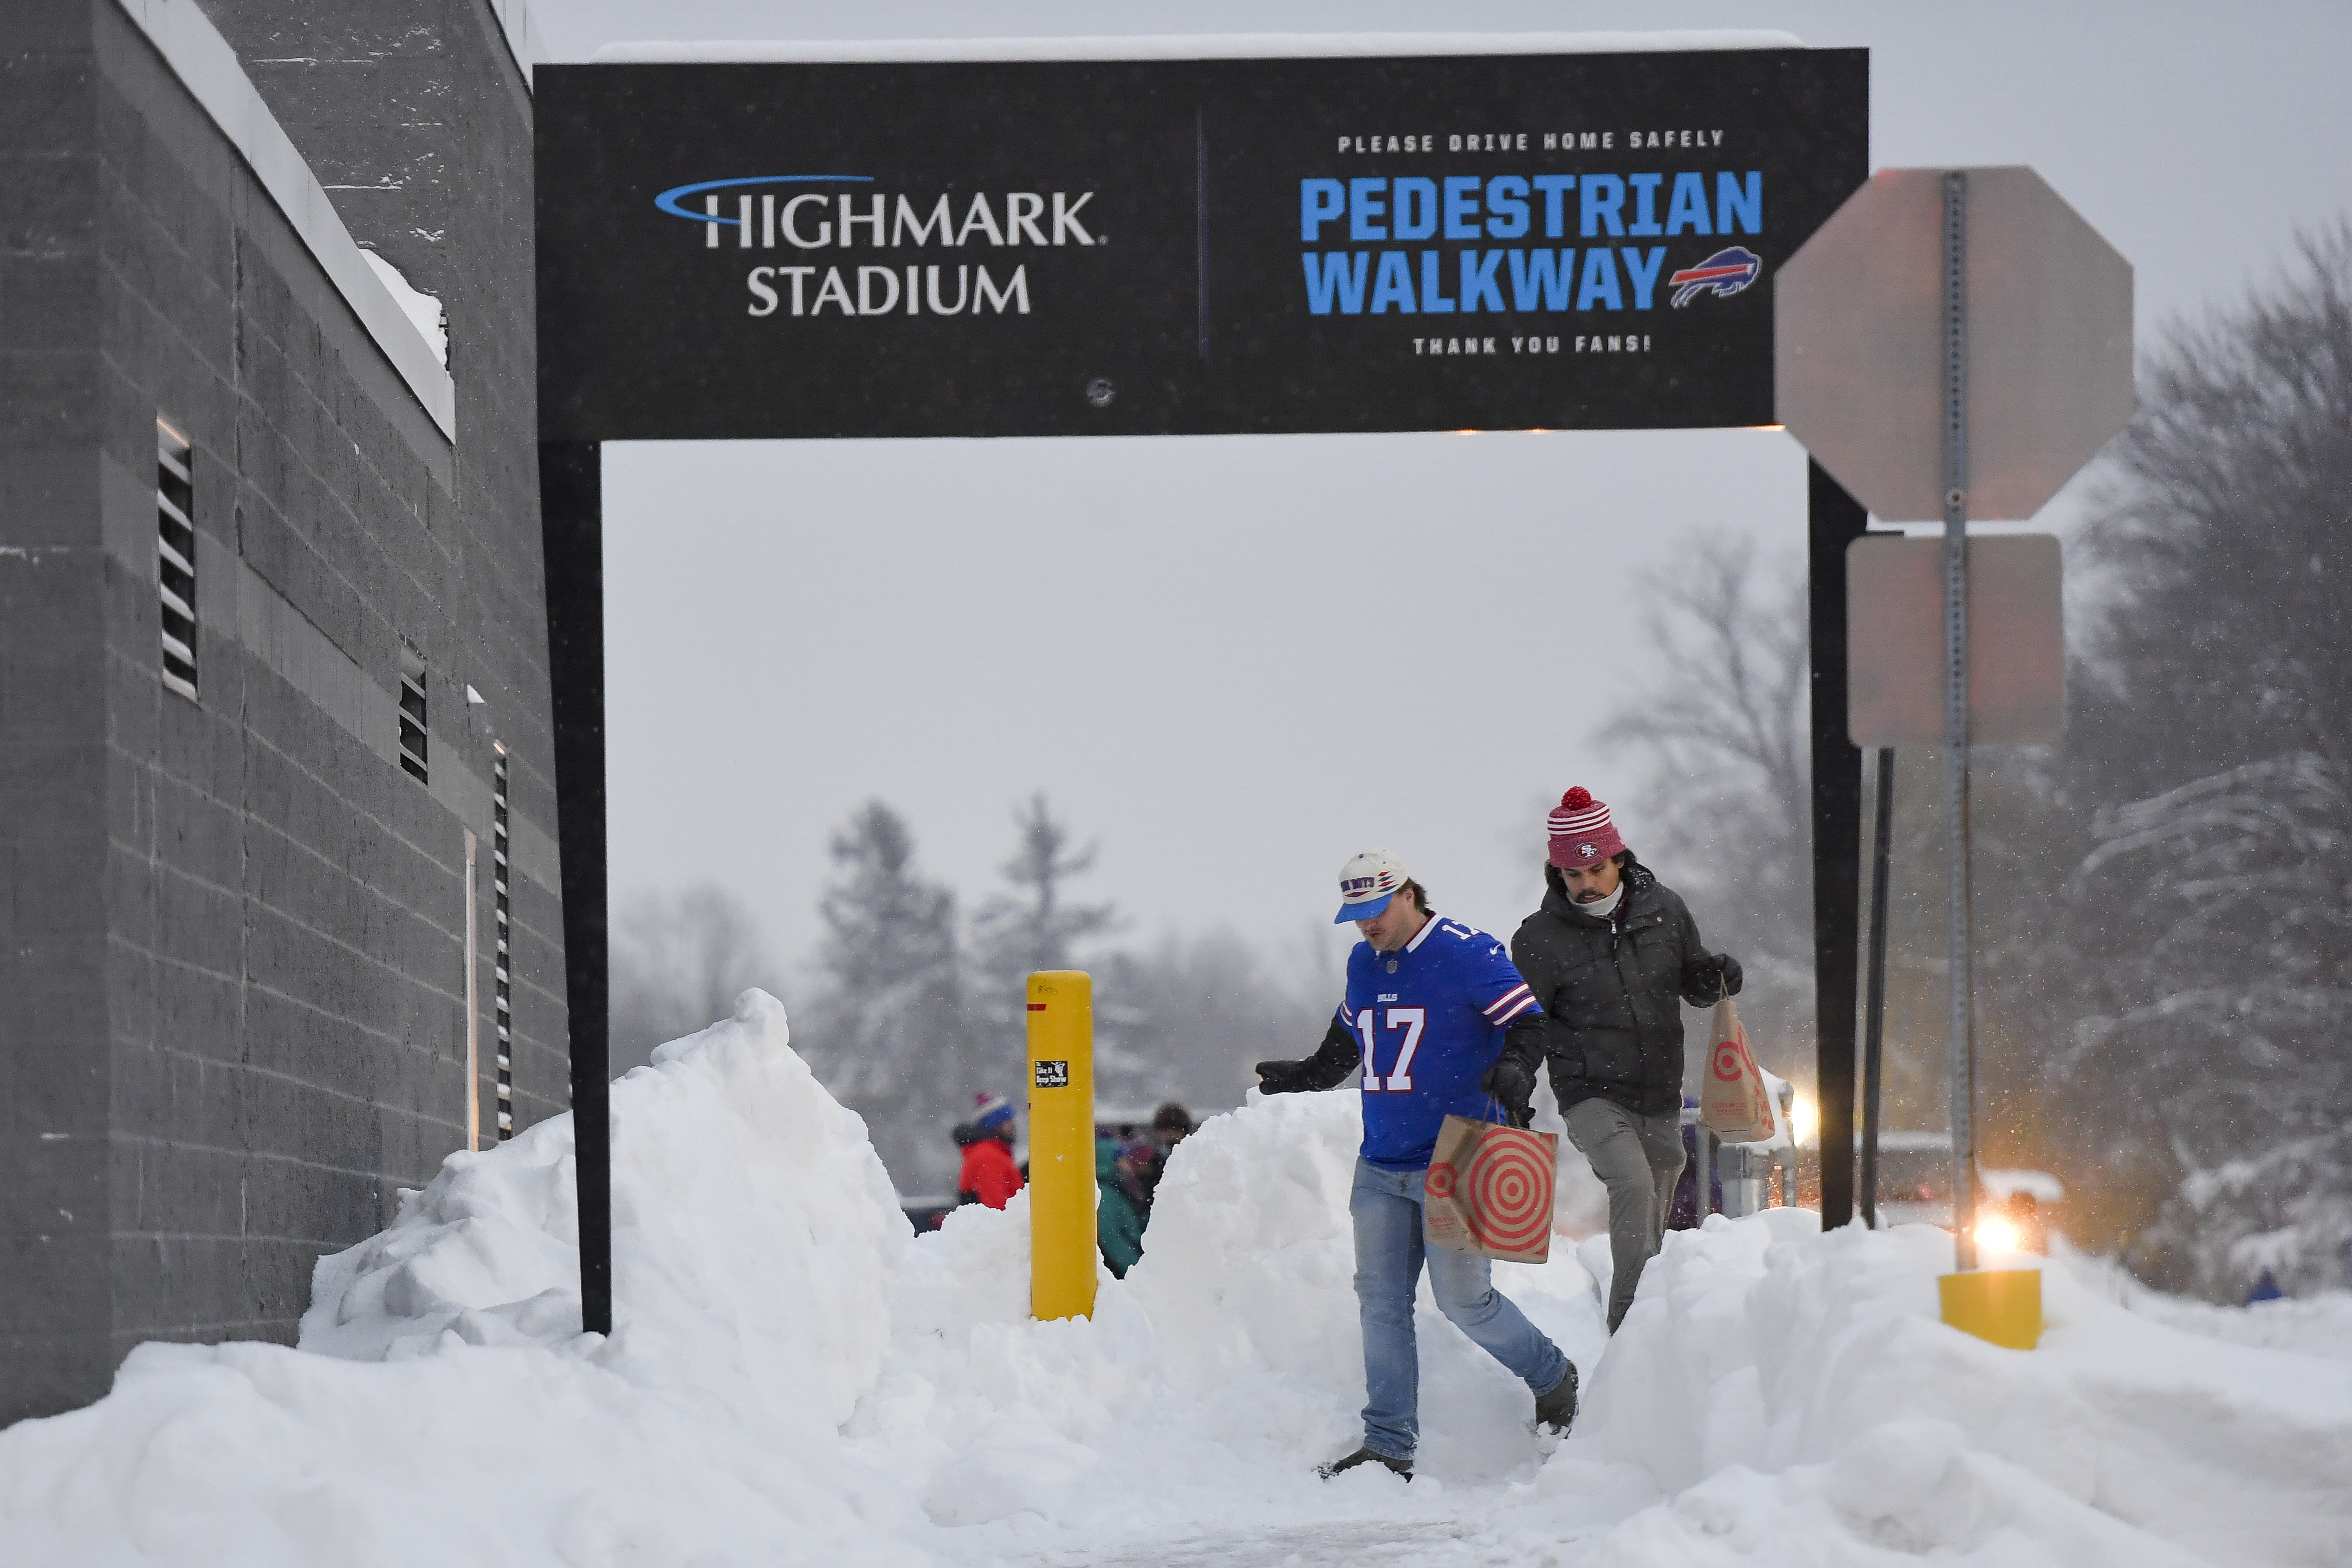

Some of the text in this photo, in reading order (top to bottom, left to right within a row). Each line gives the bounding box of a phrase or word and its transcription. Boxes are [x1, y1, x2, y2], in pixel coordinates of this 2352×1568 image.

[1338, 130, 1725, 154] PLEASE DRIVE HOME SAFELY
[1300, 170, 1762, 242] PEDESTRIAN
[747, 264, 1031, 317] STADIUM
[1301, 246, 1667, 316] WALKWAY
[1412, 334, 1652, 356] THANK YOU FANS!
[1377, 993, 1398, 1002] BILLS
[1356, 1005, 1426, 1093] 17
